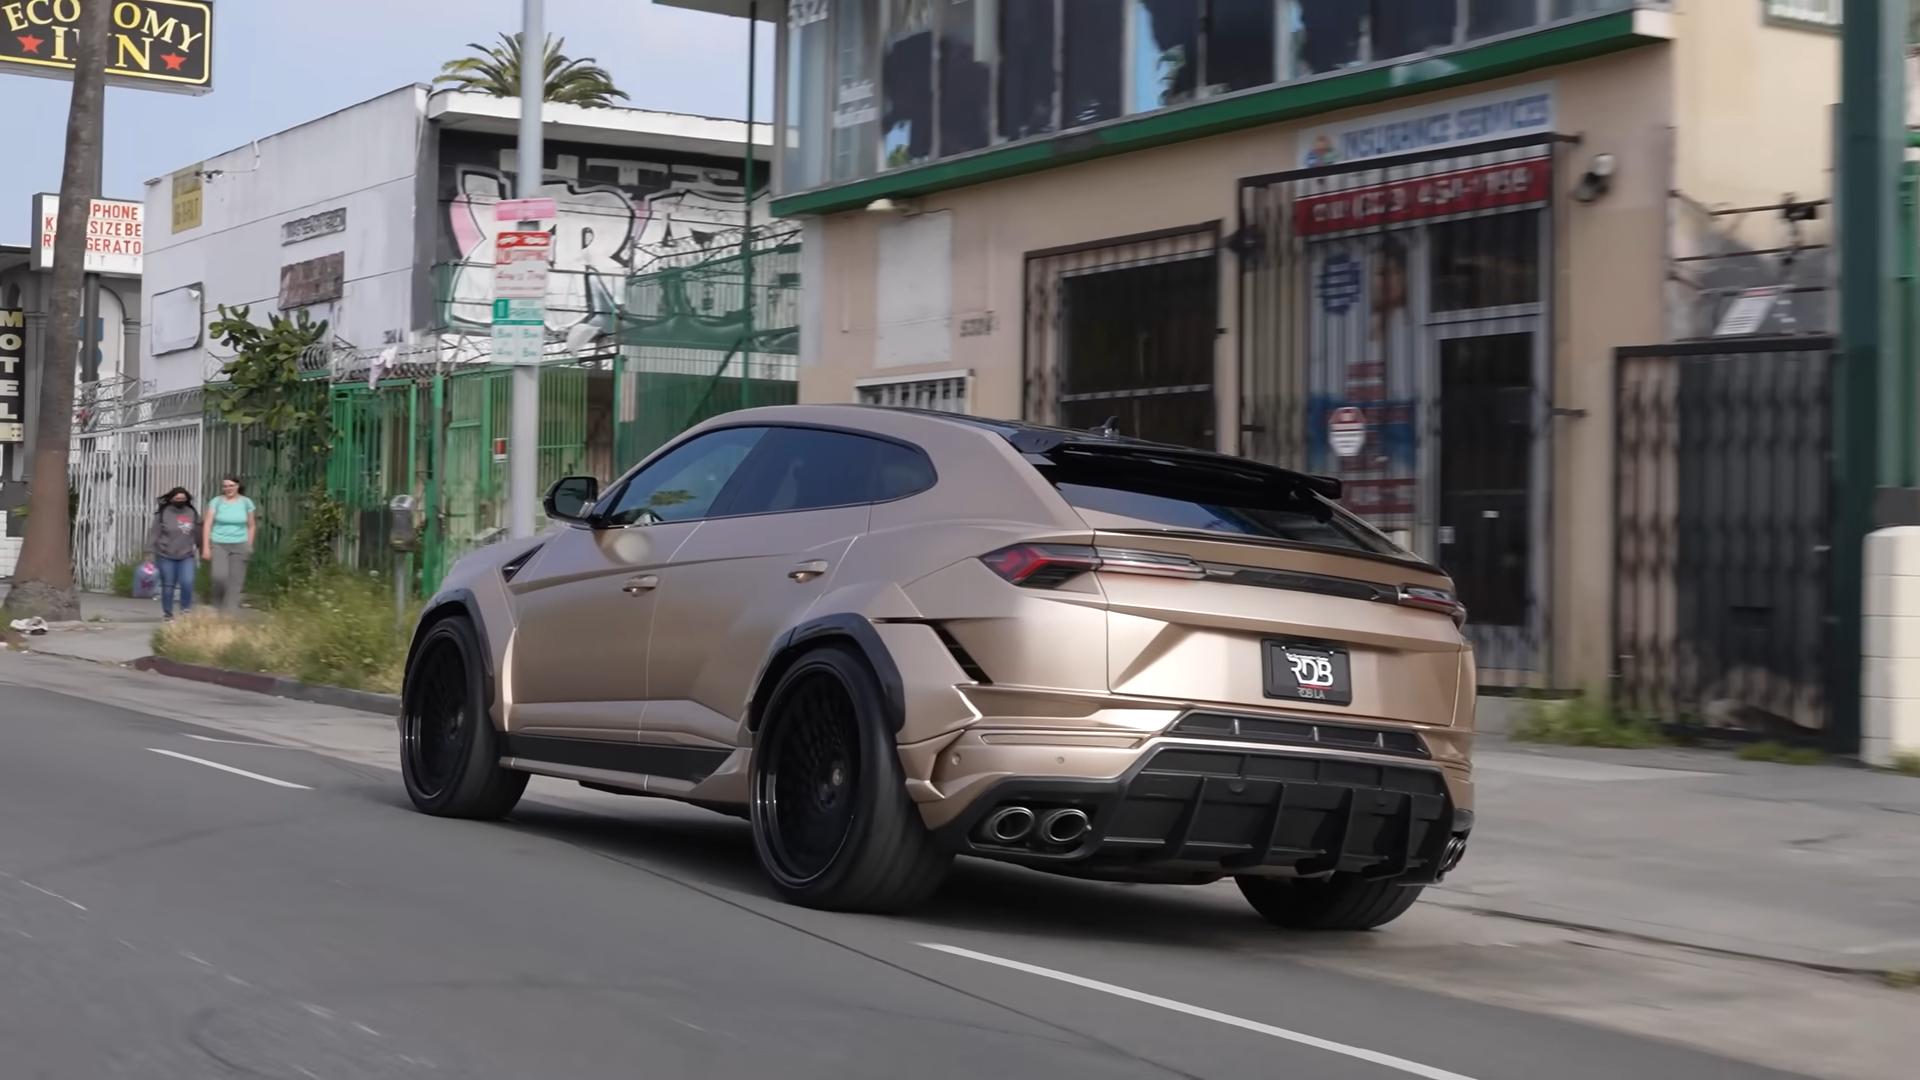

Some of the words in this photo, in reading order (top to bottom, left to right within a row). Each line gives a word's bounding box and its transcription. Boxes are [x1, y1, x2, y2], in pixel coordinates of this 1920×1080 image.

[1, 0, 203, 53] ECOOMY
[50, 25, 154, 71] IN
[90, 220, 122, 236] SIZE
[92, 203, 138, 221] PHONE
[0, 310, 23, 420] MOTEL
